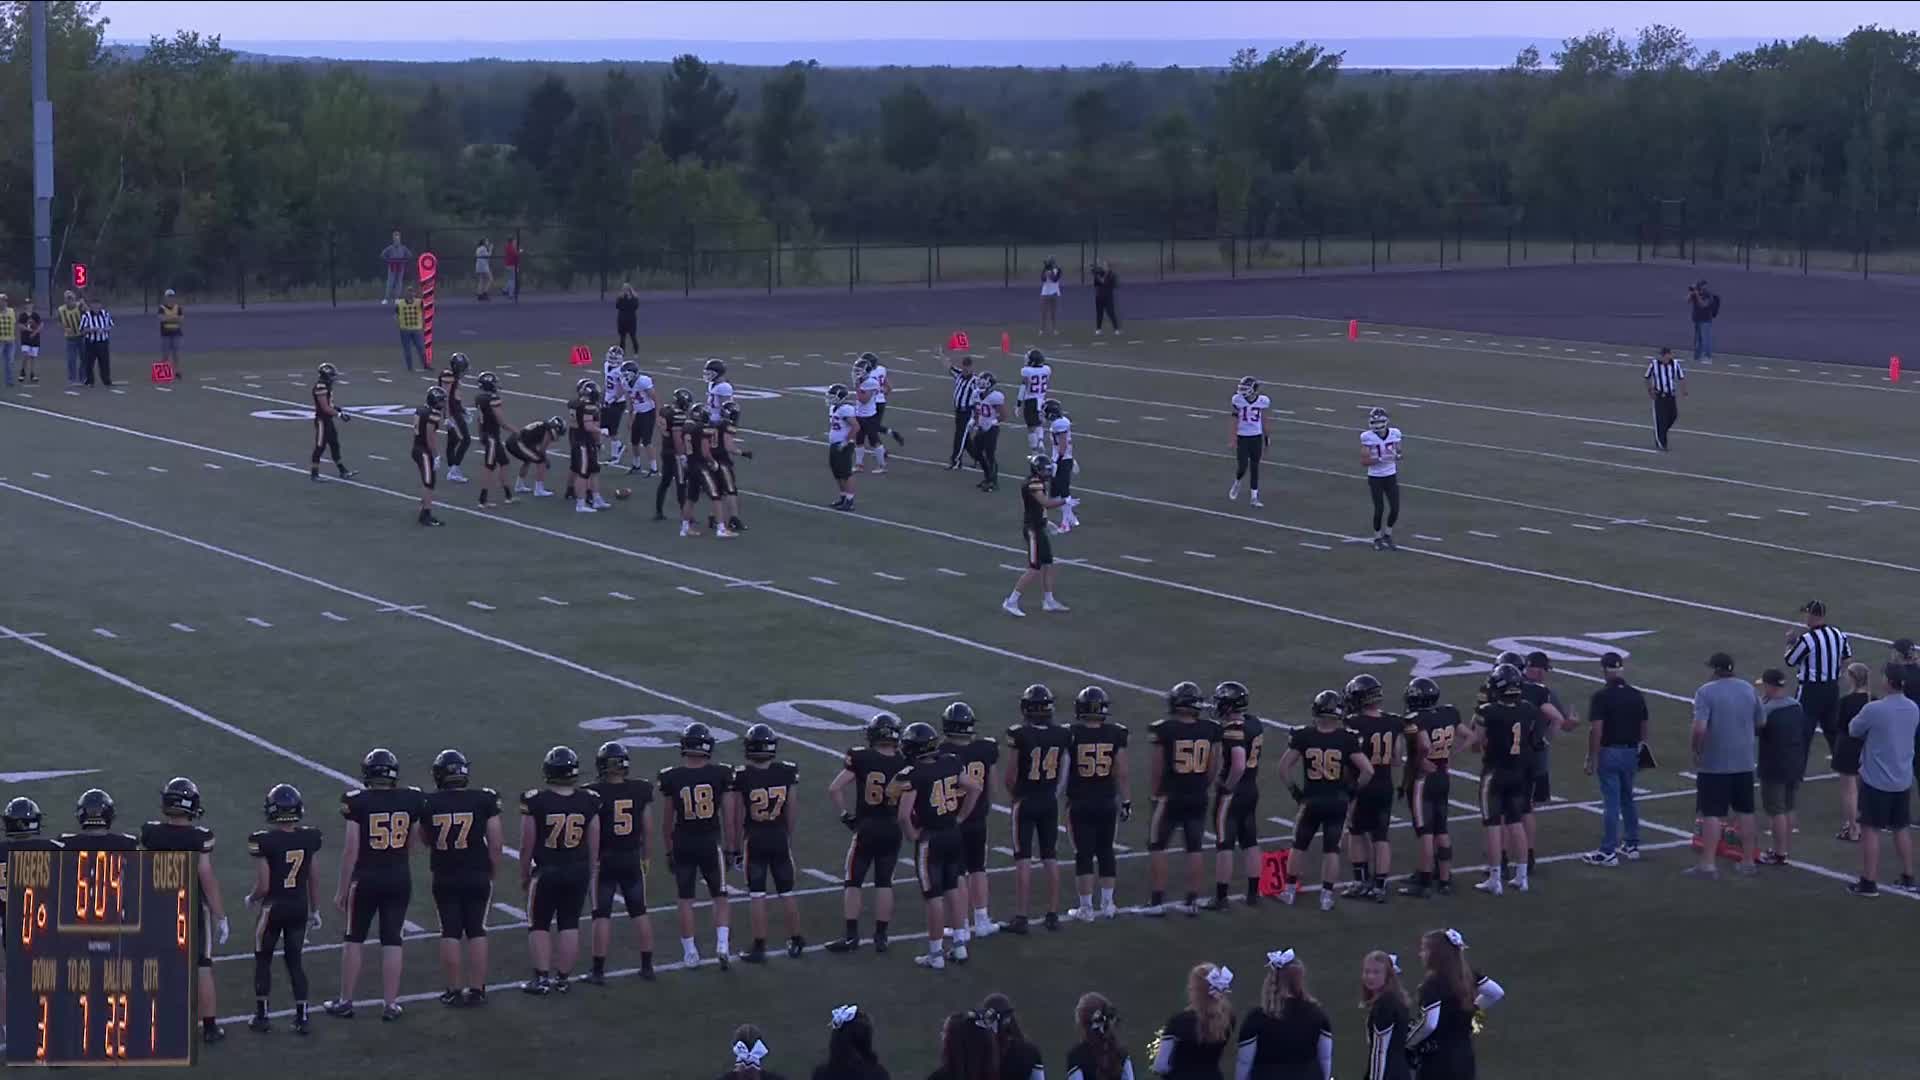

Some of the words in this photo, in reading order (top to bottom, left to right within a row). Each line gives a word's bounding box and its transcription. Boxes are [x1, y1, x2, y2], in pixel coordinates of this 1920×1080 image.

[74, 265, 86, 285] 3
[155, 362, 173, 379] 20
[575, 347, 591, 361] 10
[1030, 374, 1048, 394] 22
[1241, 406, 1261, 422] 13
[1344, 636, 1631, 678] 20
[1370, 731, 1394, 766] 11
[1509, 721, 1522, 755] 1
[1027, 746, 1060, 781] 14
[1076, 743, 1115, 778] 55
[1173, 739, 1211, 774] 50
[1304, 747, 1342, 781] 36
[679, 783, 714, 821] 18
[749, 786, 788, 822] 27
[929, 774, 962, 816] 45
[368, 811, 410, 850] 58
[432, 812, 475, 850] 77
[545, 813, 586, 849] 76
[613, 799, 634, 836] 5
[283, 849, 305, 889] 7
